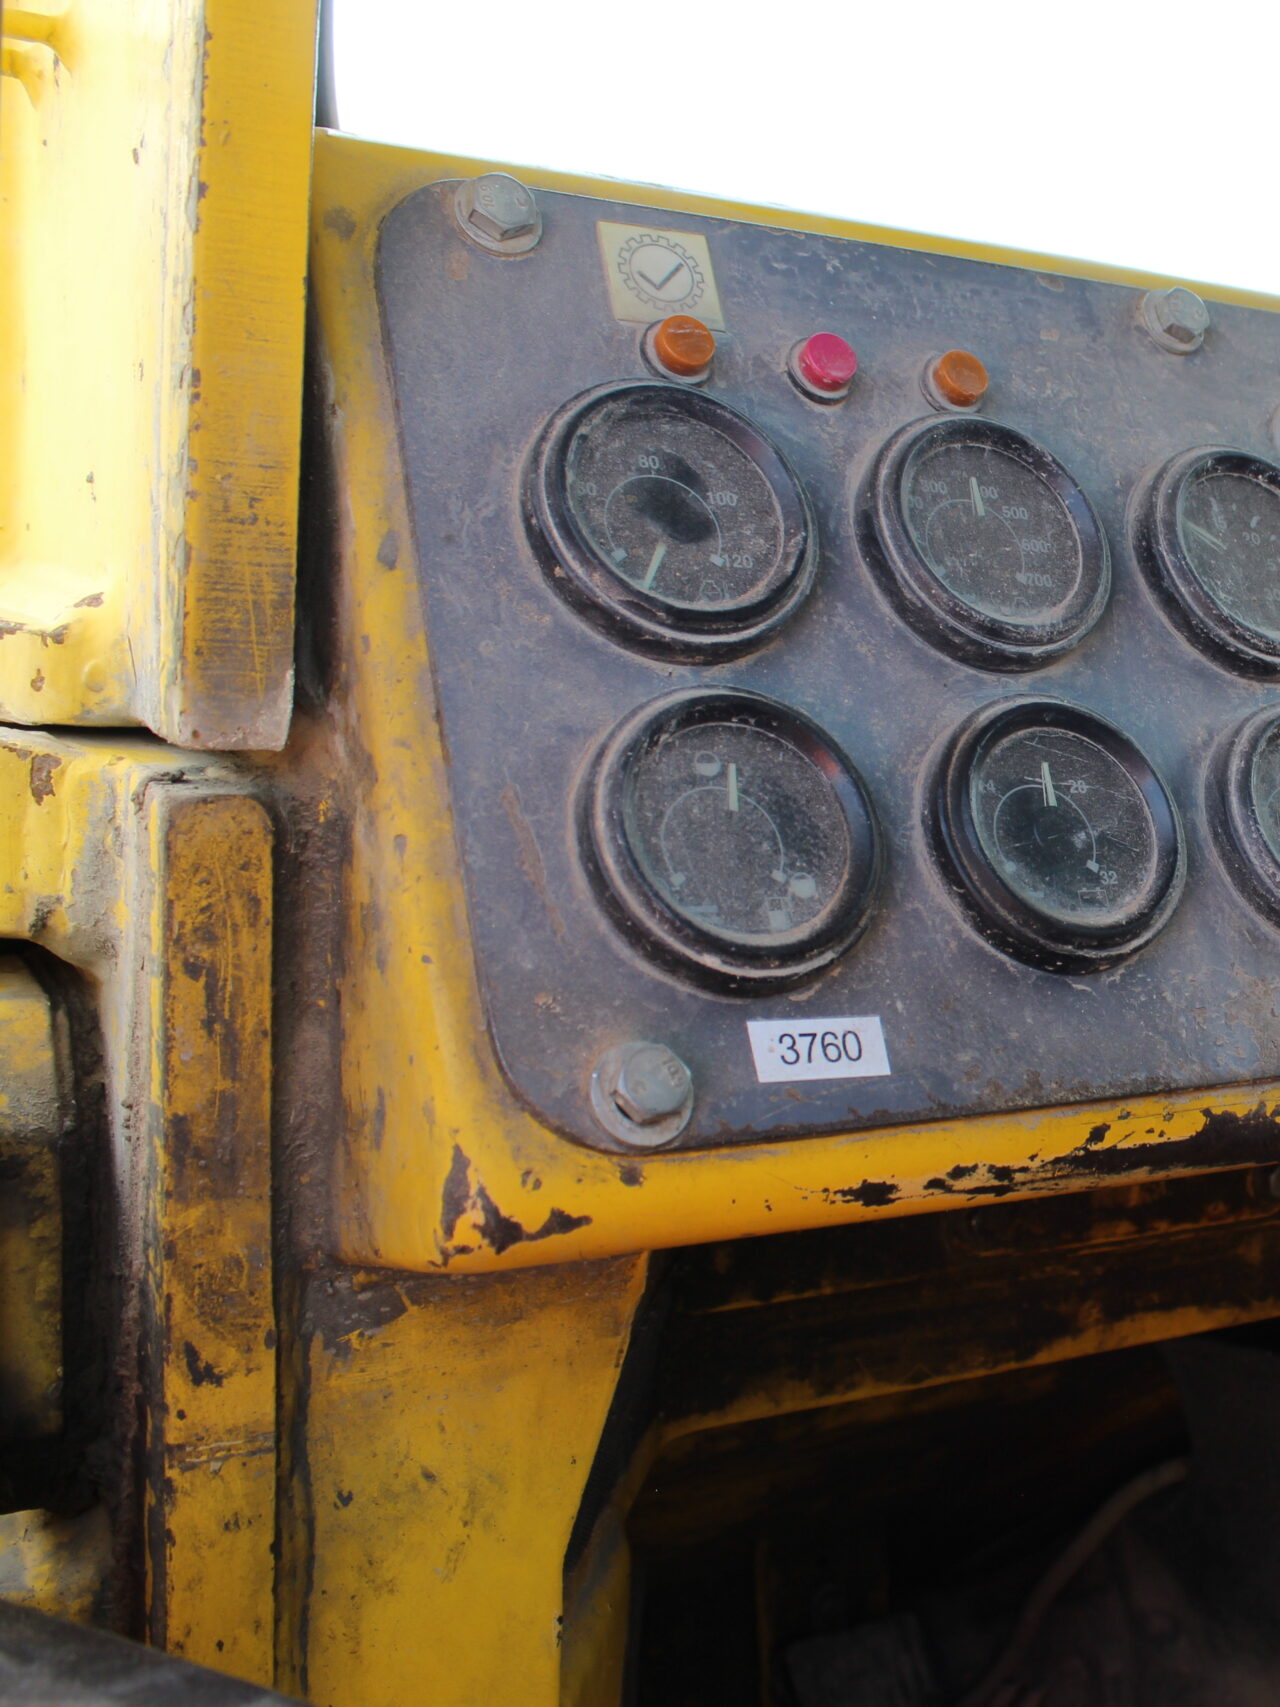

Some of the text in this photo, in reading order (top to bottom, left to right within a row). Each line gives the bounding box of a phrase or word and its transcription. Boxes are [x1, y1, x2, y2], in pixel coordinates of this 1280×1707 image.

[638, 454, 660, 470] 80
[706, 490, 738, 506] 100
[1001, 506, 1028, 520] 500
[1099, 870, 1118, 885] 32
[778, 1030, 862, 1065] 3760
